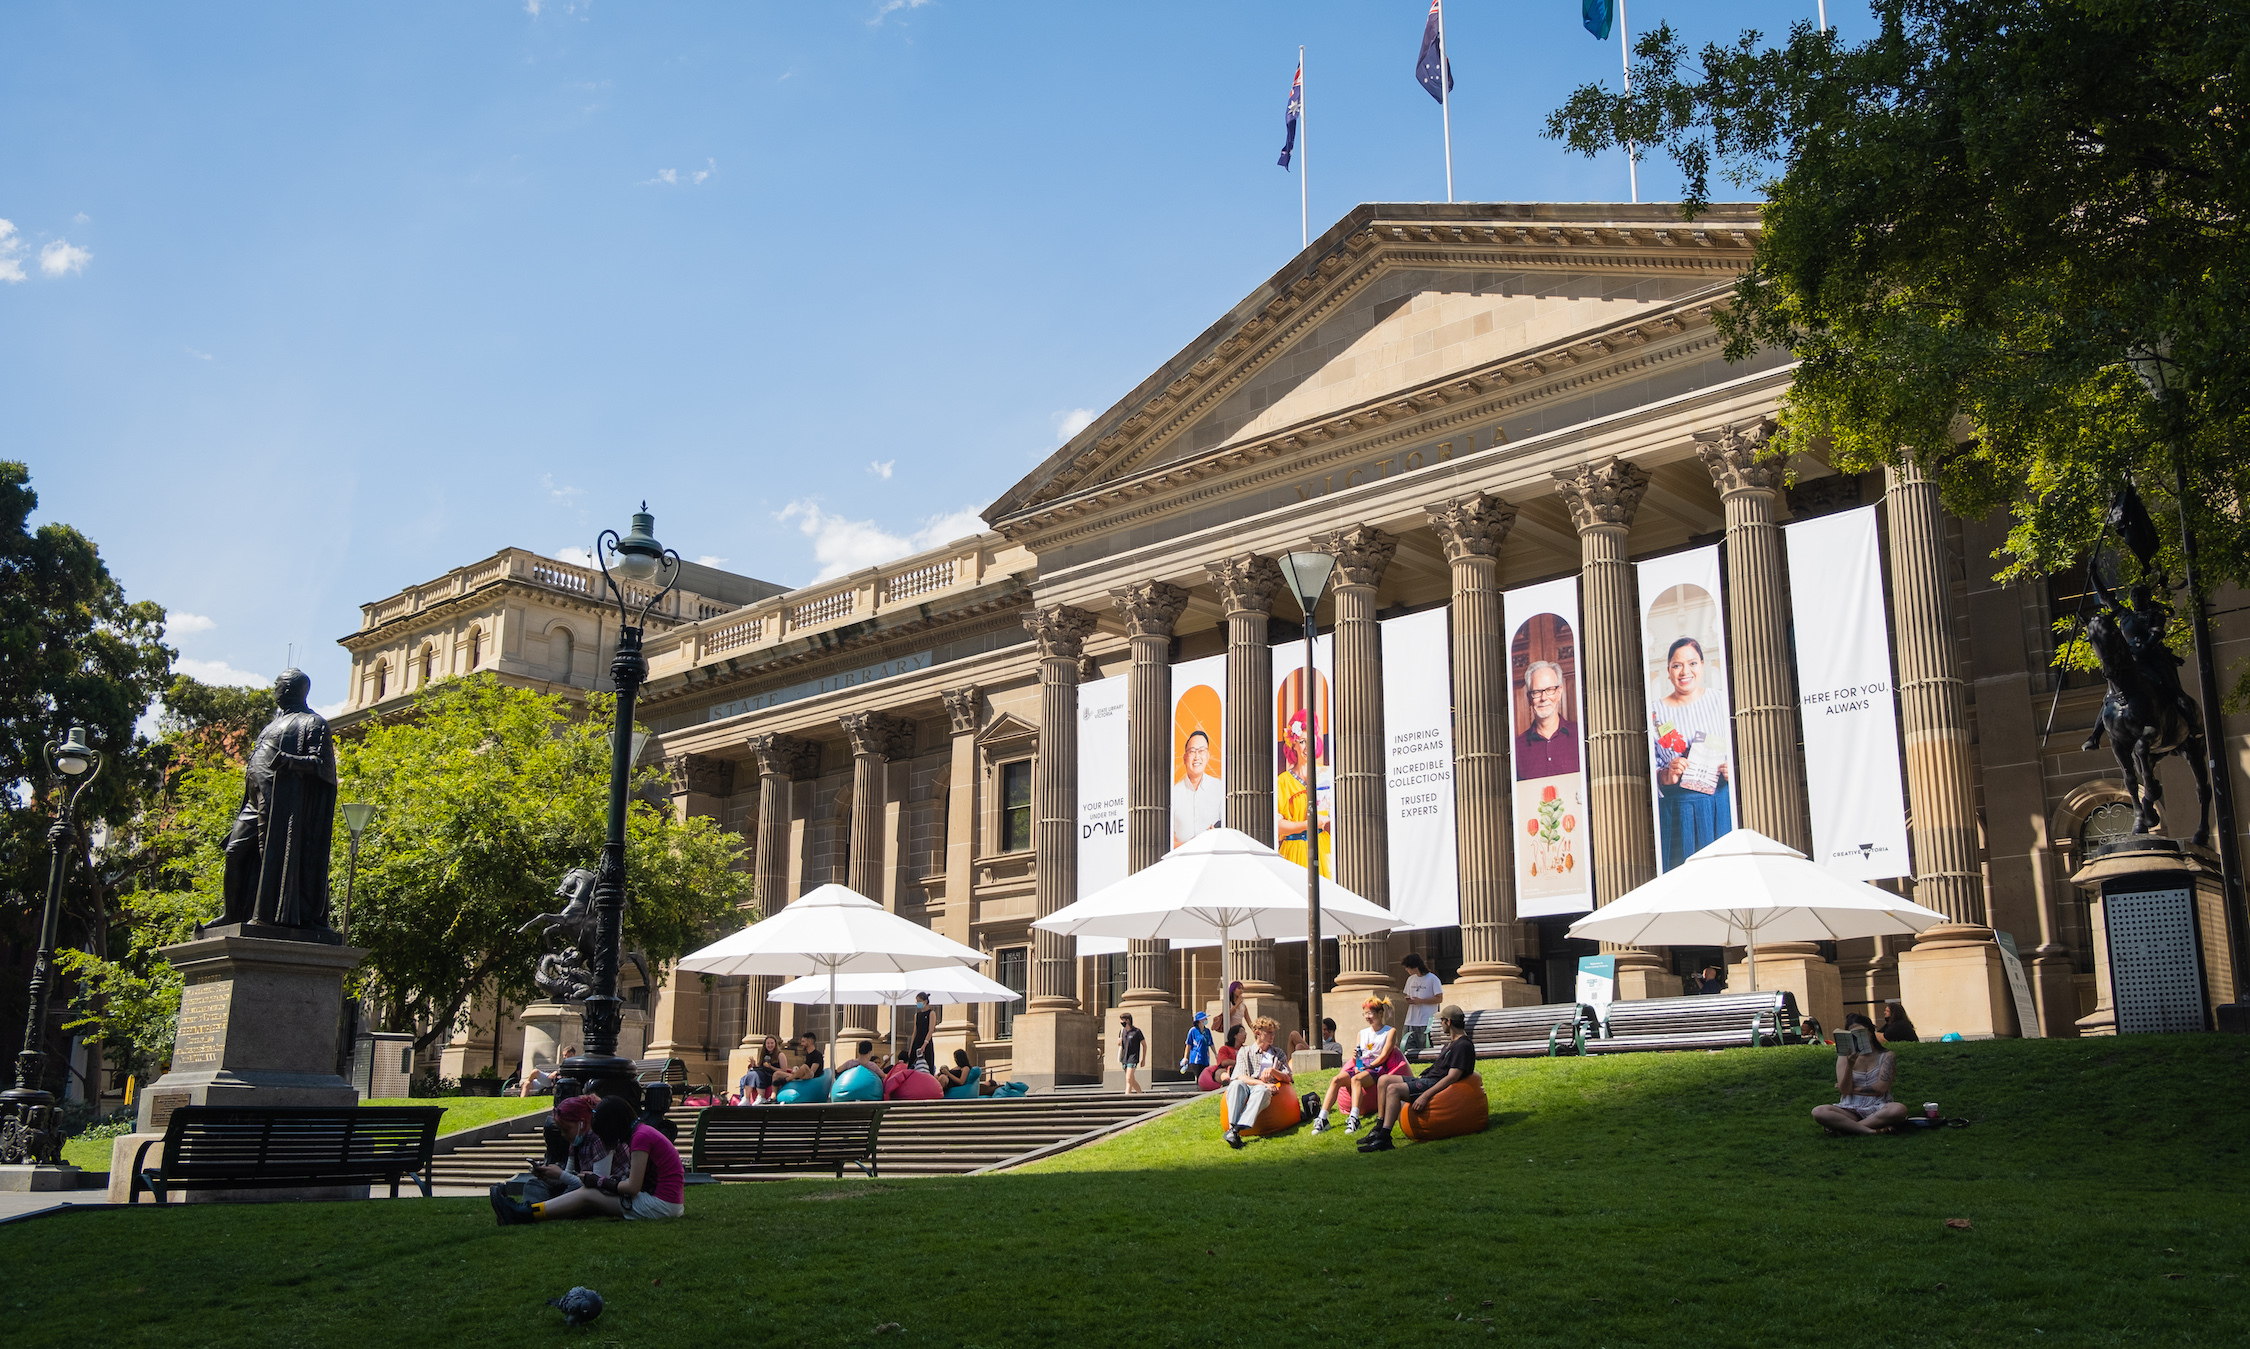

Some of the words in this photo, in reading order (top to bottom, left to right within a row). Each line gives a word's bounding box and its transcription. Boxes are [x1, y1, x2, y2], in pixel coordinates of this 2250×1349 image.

[1294, 427, 1510, 500] VICTORIA
[714, 693, 779, 720] STATE
[819, 655, 926, 694] LIBRARY
[1804, 692, 1830, 705] HERE
[1834, 687, 1857, 700] FOR
[1860, 682, 1889, 695] YOU,
[1108, 704, 1124, 712] LIBRARY
[1826, 699, 1870, 715] ALWAYS
[1395, 729, 1439, 743] INSPIRING
[1392, 740, 1444, 756] PROGRAMS
[1393, 760, 1444, 775] INCREDIBLE
[1389, 771, 1450, 788] COLLECTIONS
[1083, 802, 1102, 811] YOUR
[1104, 797, 1124, 808] HOME
[1401, 792, 1437, 805] TRUSTED
[1090, 812, 1107, 820] UNDER
[1401, 805, 1438, 818] EXPERTS
[1083, 818, 1124, 839] DOME
[1832, 849, 1861, 858] CREATIVE
